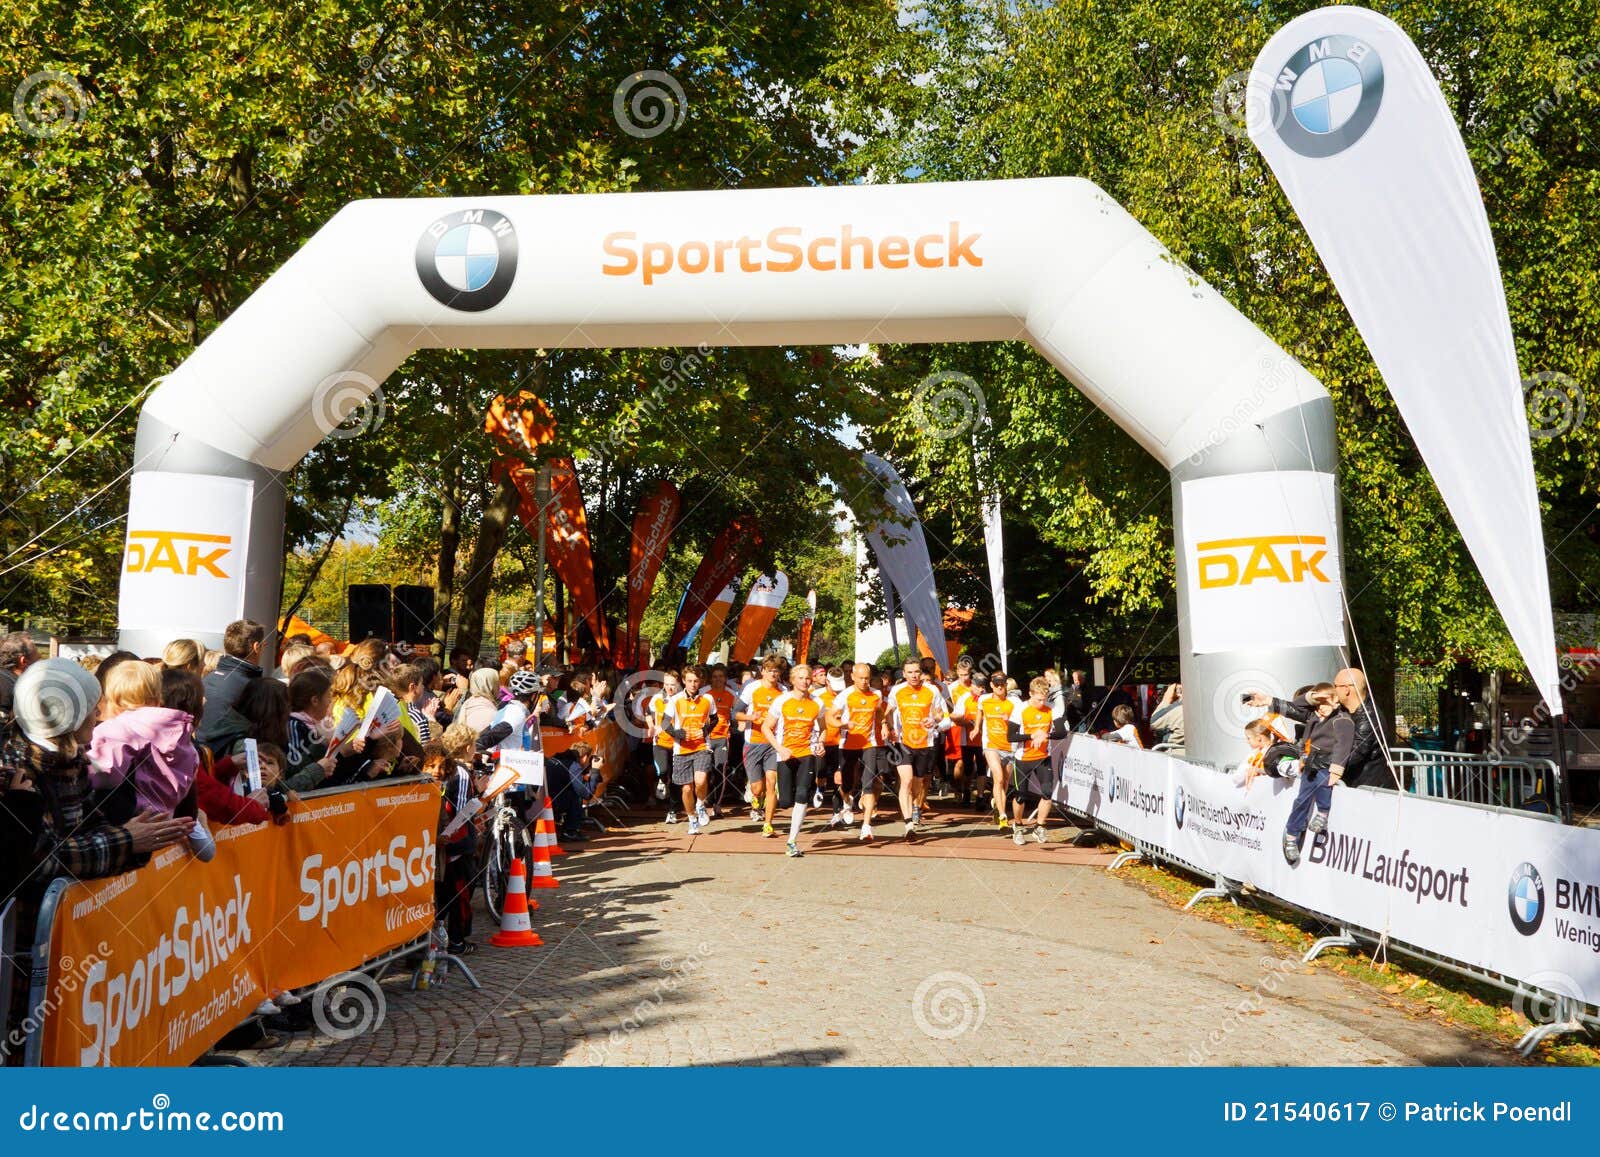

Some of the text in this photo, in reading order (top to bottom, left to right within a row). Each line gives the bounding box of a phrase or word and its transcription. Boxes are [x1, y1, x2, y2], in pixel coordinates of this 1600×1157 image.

[428, 209, 513, 239] BMW
[602, 220, 984, 286] SportScheck
[1196, 535, 1331, 590] DAK
[293, 801, 356, 823] www.sportscheck.com
[1309, 829, 1469, 908] BMW Laufsport
[386, 904, 404, 931] Wir
[80, 874, 253, 1067] SportScheck
[168, 1010, 188, 1055] Wir
[188, 987, 232, 1038] machen
